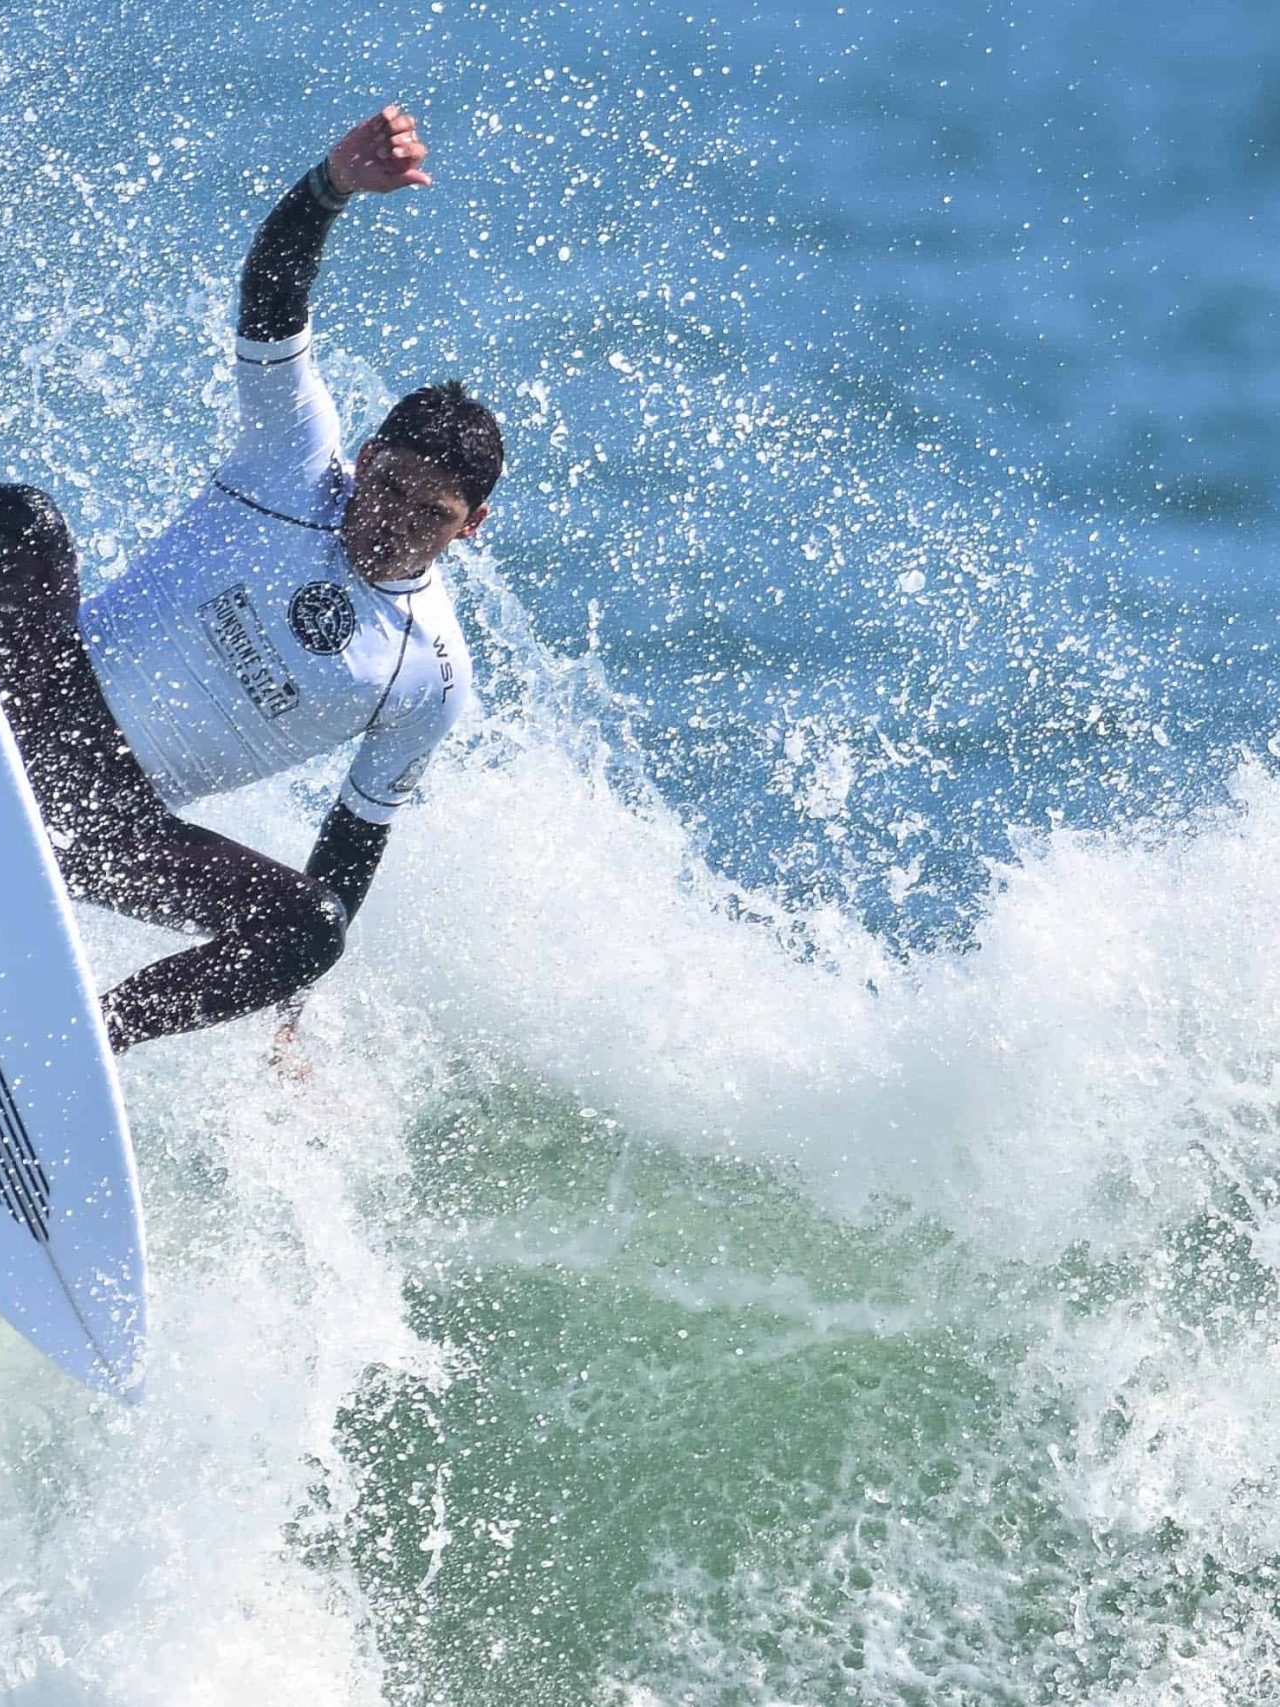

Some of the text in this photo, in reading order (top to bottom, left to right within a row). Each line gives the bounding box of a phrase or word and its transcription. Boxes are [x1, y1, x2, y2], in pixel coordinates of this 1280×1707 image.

[214, 599, 262, 668] SUNSHINE
[252, 668, 288, 713] STATE
[432, 637, 455, 704] WSL
